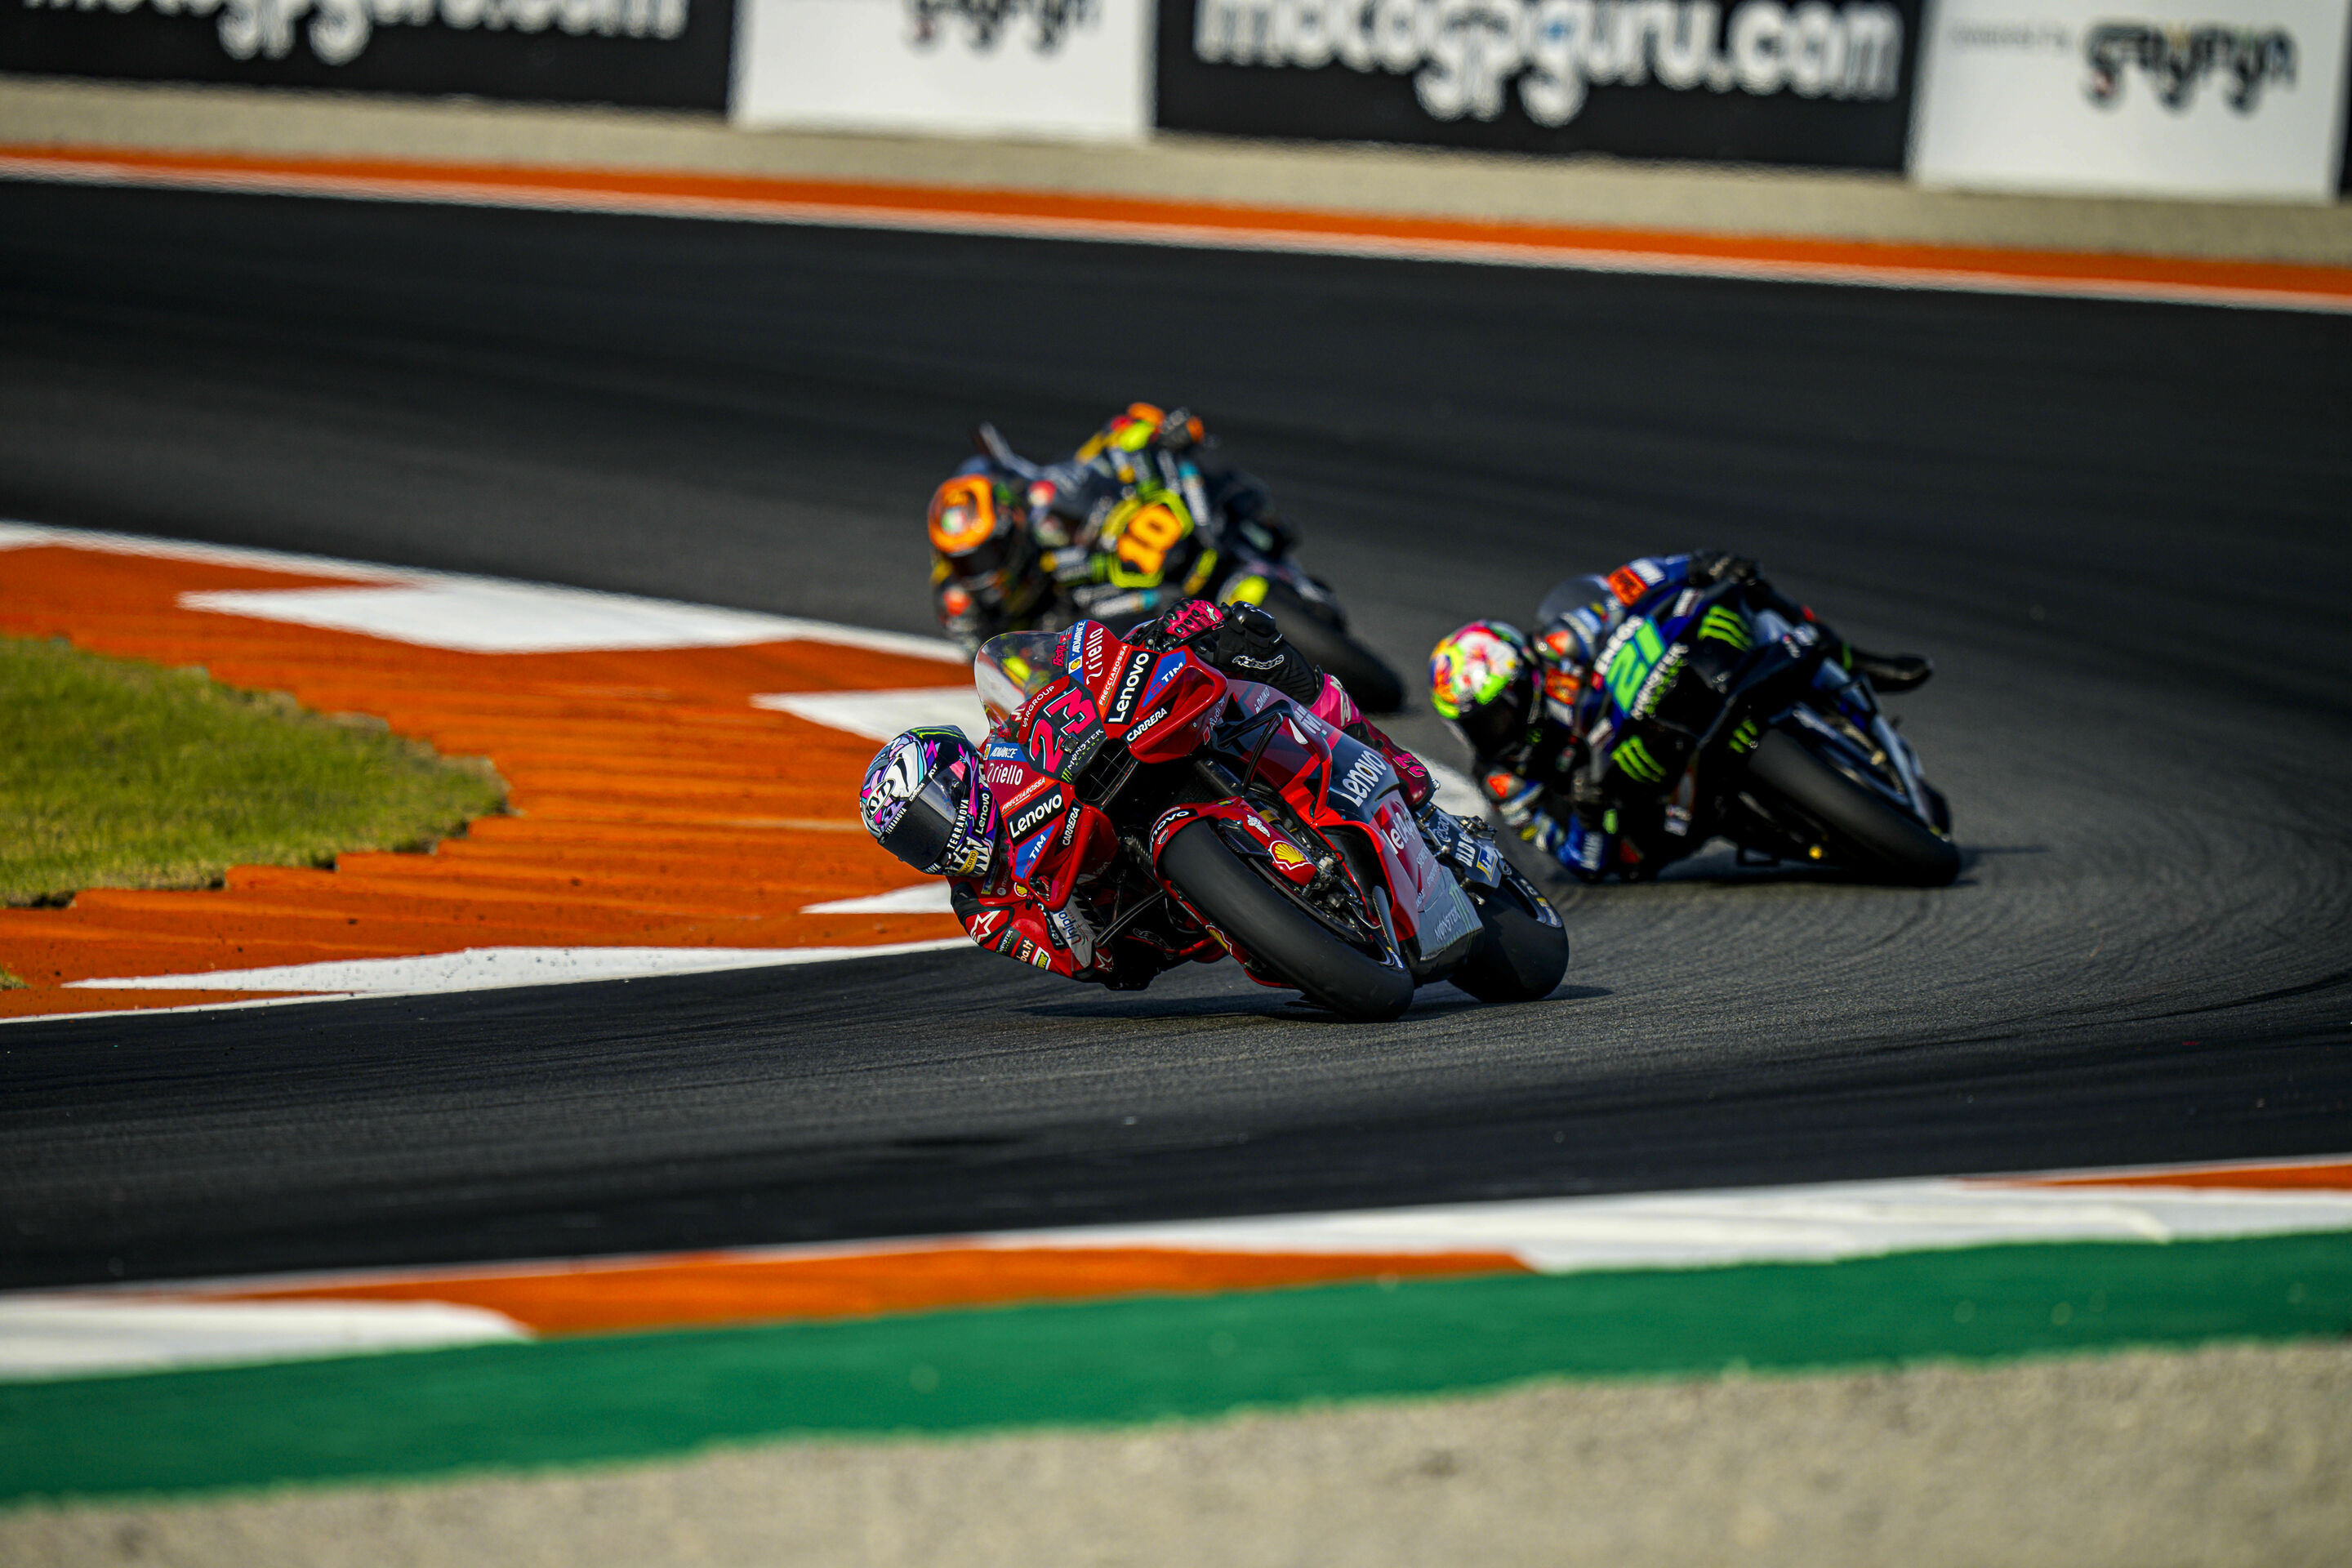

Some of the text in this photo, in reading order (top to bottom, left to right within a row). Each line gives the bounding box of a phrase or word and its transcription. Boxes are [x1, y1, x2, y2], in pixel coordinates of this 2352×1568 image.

[1116, 503, 1183, 575] 10
[1072, 621, 1085, 653] ADVANCE
[1098, 645, 1128, 706] FRECCIAROSSA
[1161, 662, 1183, 684] TIM
[1606, 621, 1664, 710] 21
[1022, 685, 1055, 728] VARGROUP
[1108, 653, 1149, 723] Lenovo
[1030, 687, 1097, 774] 23
[1126, 707, 1168, 742] CARRERA
[991, 764, 1023, 786] riello
[1001, 777, 1045, 813] FRECCIAROSSA
[1330, 751, 1387, 808] Lenovo
[885, 808, 907, 835] TERRANOVA
[947, 800, 969, 849] TERRANOVA
[975, 792, 990, 835] Lenovo
[1009, 794, 1062, 838] Lenovo
[1062, 807, 1080, 846] CARRERA
[1029, 834, 1047, 859] TIM
